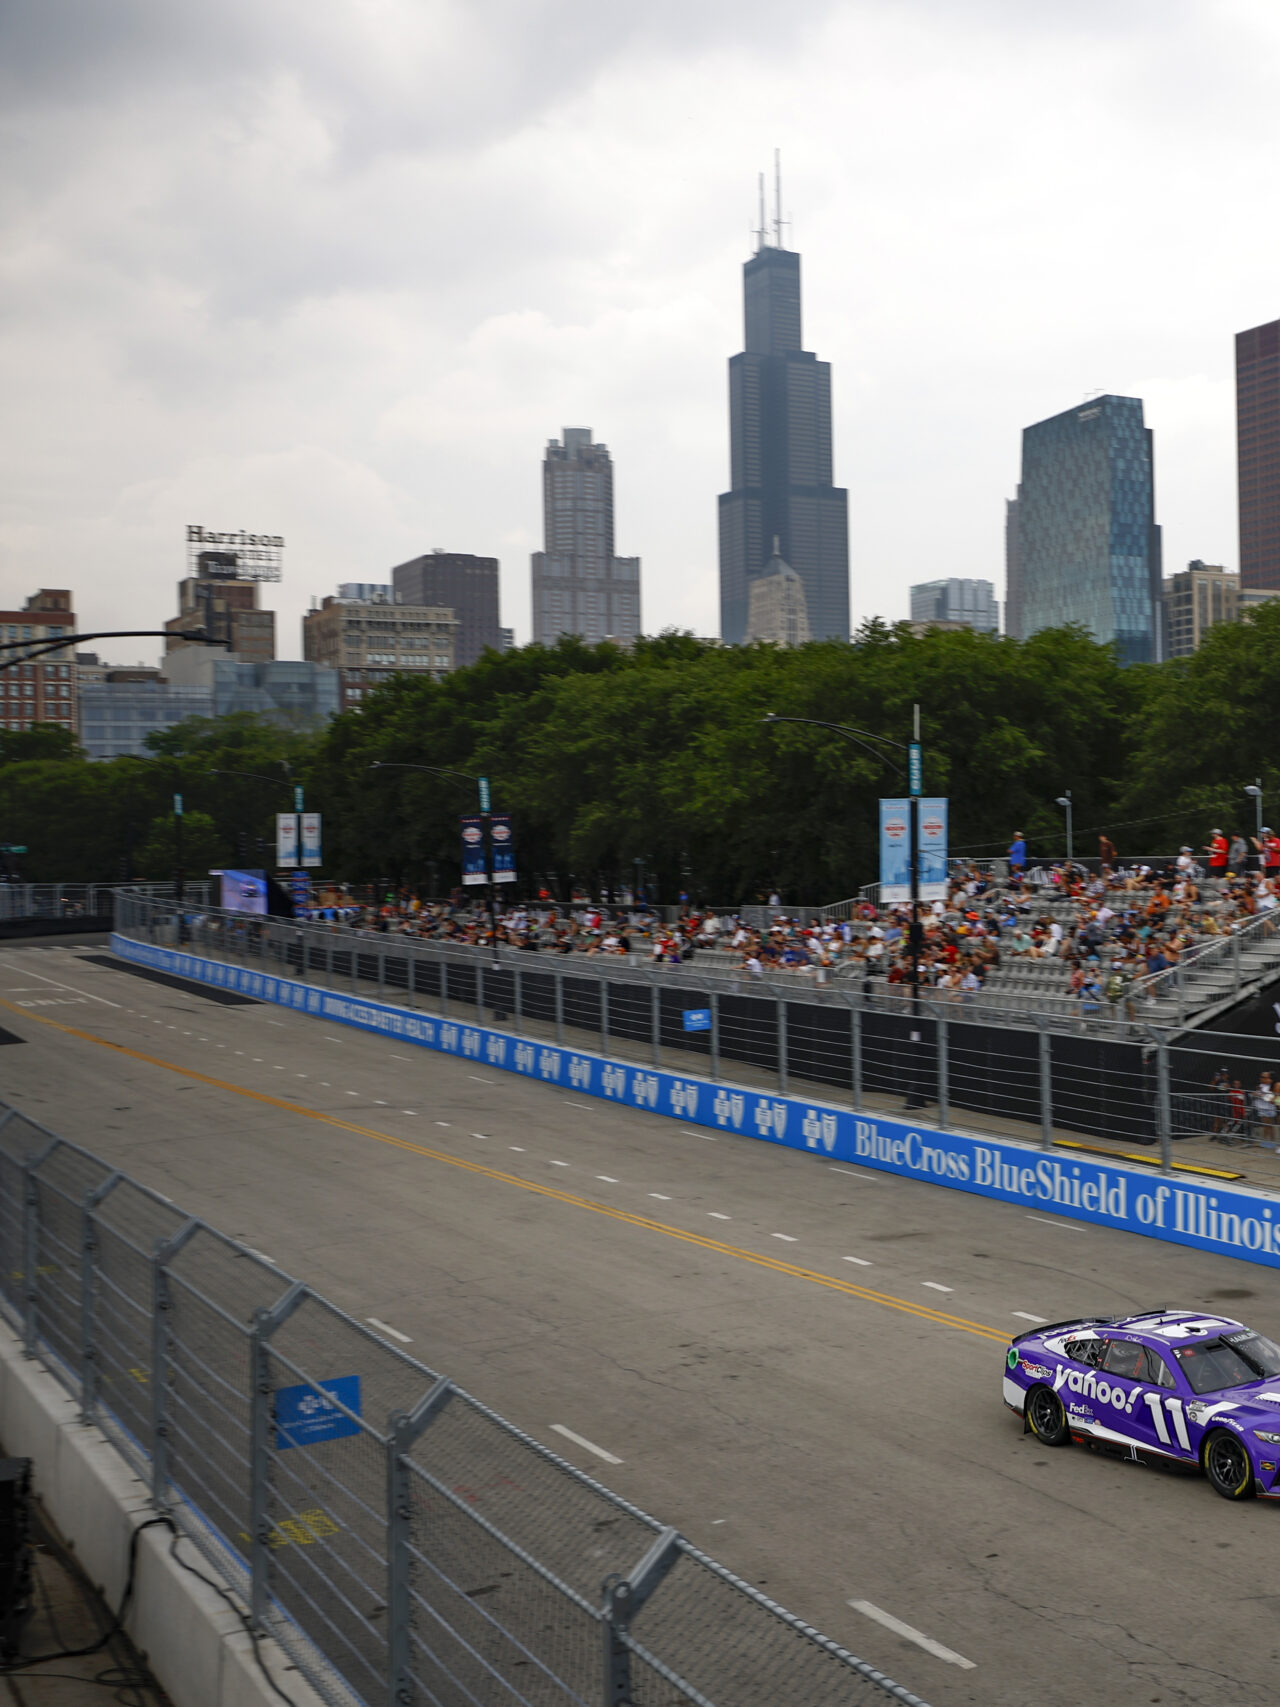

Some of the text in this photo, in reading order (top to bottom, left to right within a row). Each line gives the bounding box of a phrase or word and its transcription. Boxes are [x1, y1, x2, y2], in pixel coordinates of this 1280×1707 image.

[185, 525, 285, 547] Harrison
[855, 1121, 970, 1181] BlueCross
[973, 1146, 1129, 1219] BlueShield
[1135, 1185, 1170, 1227] of
[1052, 1364, 1144, 1414] yahoo!
[1069, 1402, 1094, 1416] FedEx
[1143, 1391, 1193, 1453] 11
[1211, 1416, 1244, 1431] GOODYEAR
